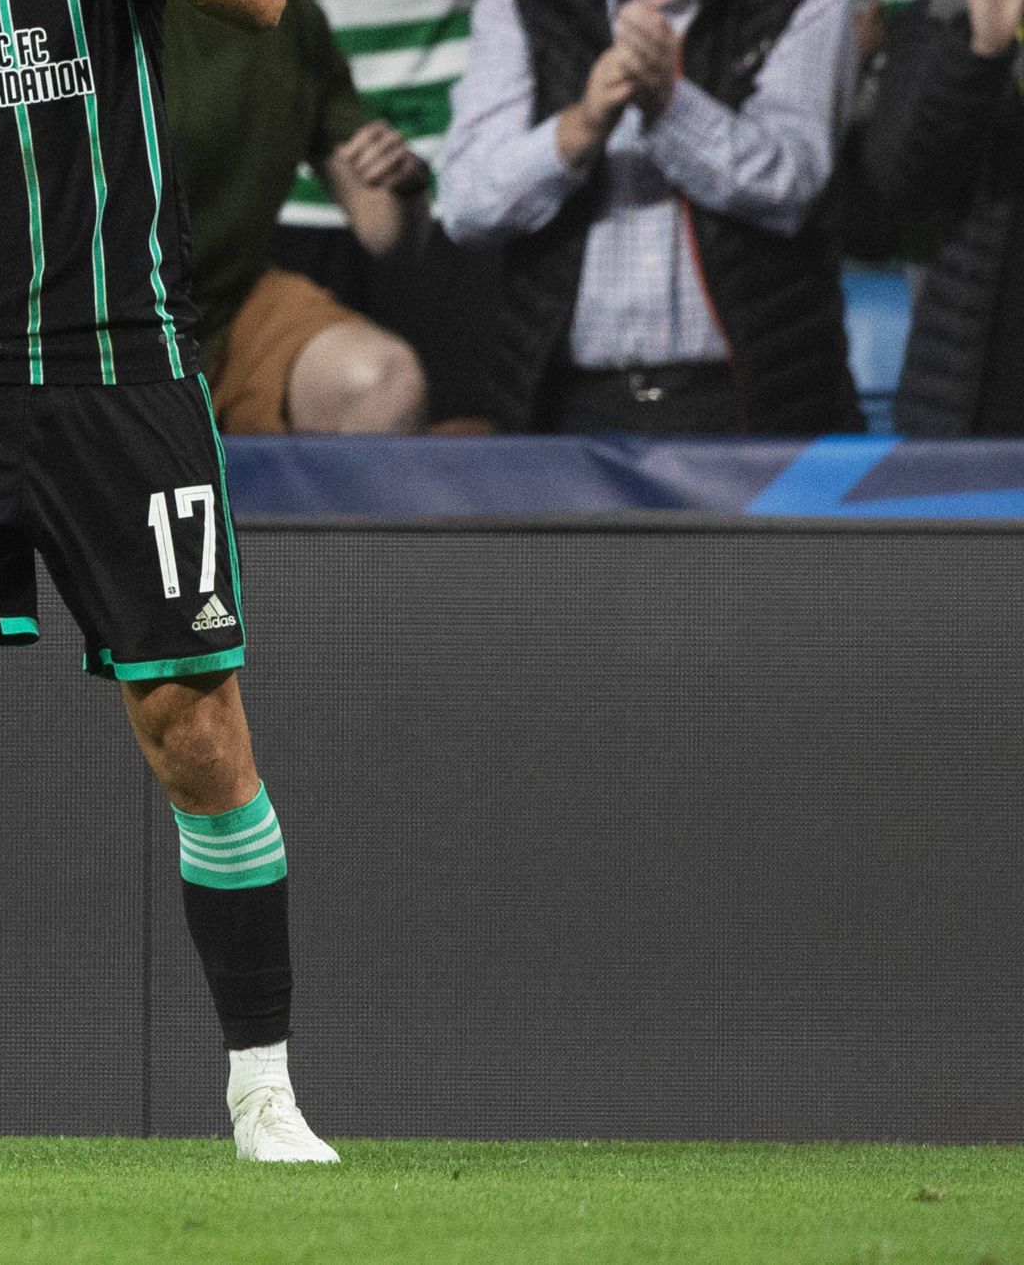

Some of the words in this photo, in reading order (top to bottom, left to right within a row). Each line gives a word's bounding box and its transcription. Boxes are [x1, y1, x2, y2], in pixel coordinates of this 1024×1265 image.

[15, 28, 49, 67] FC
[147, 484, 217, 600] 17
[191, 614, 237, 631] adidas
